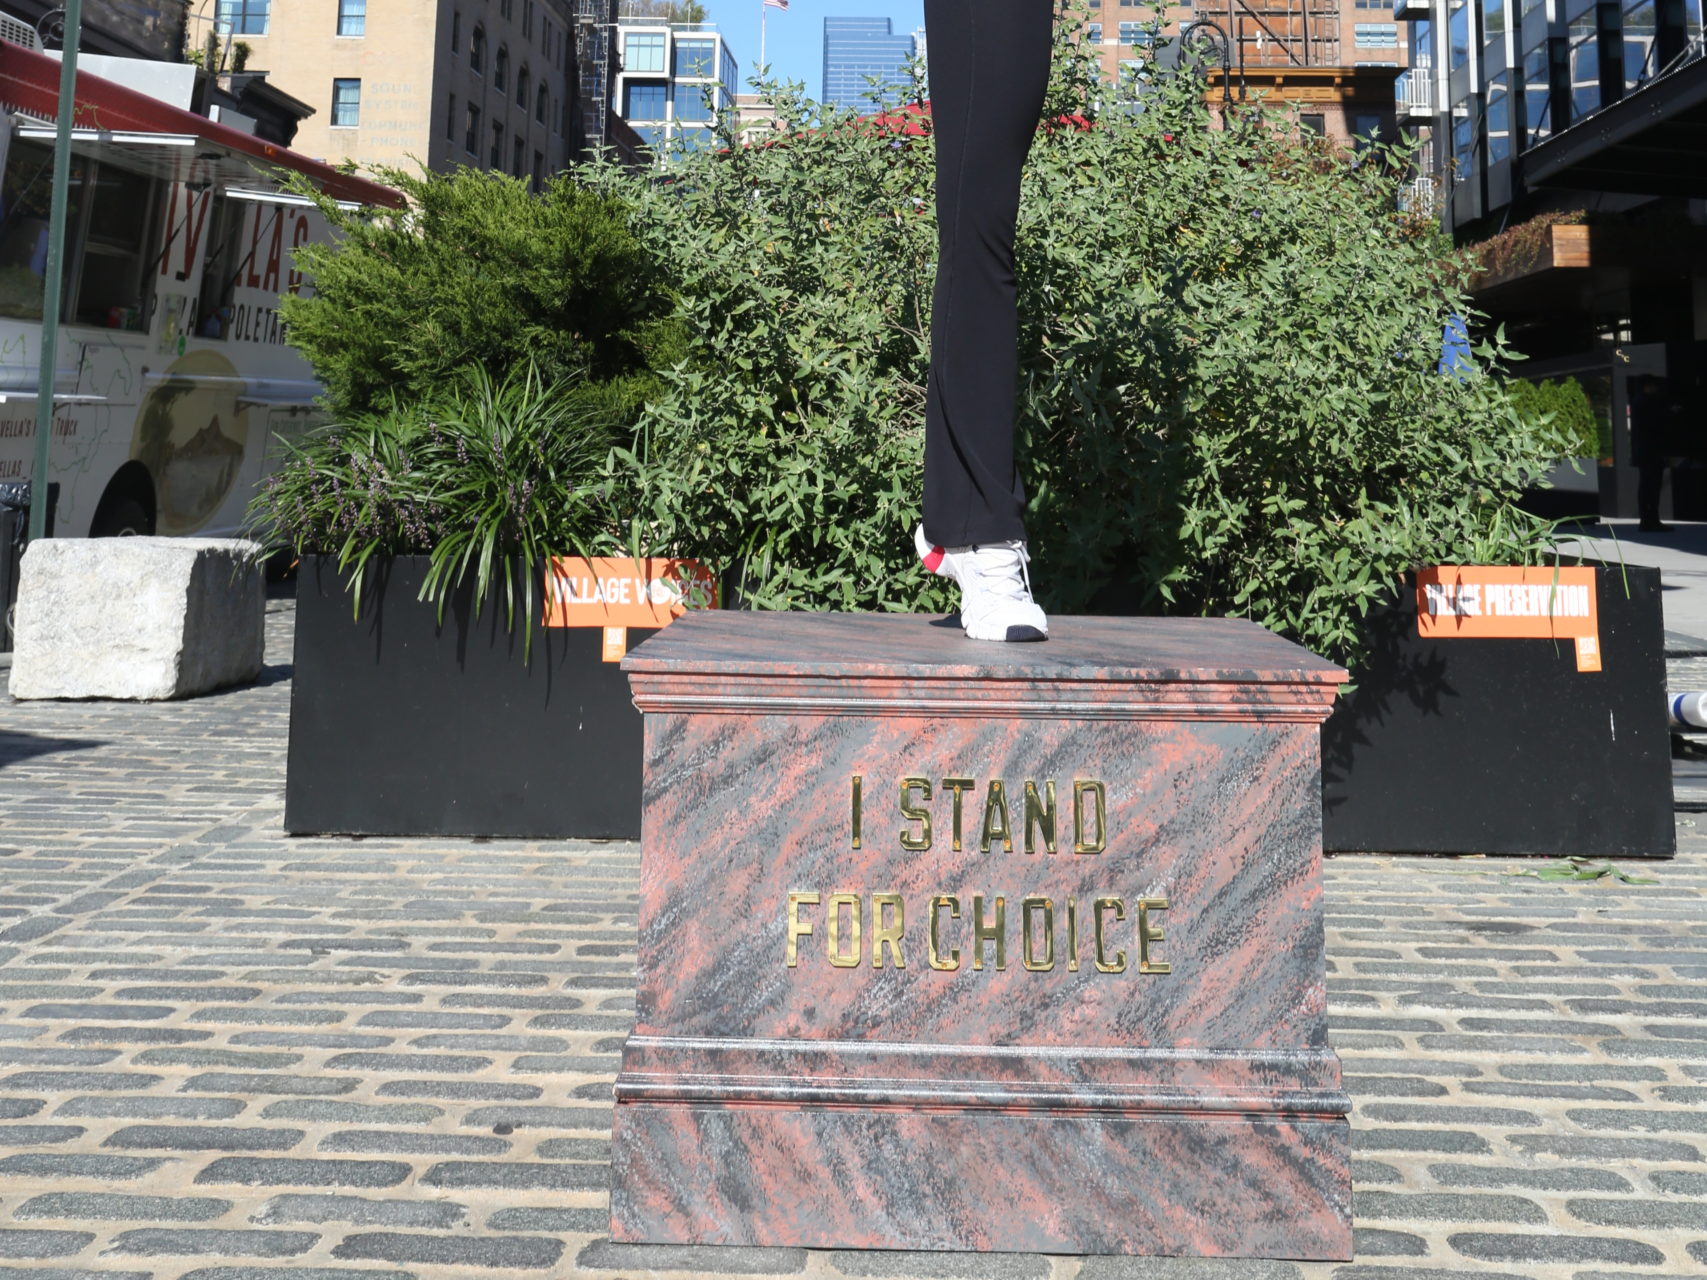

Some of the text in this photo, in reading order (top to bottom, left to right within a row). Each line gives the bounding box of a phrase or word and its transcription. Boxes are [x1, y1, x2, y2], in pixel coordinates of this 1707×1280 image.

[552, 576, 631, 605] VILLAGE
[1425, 583, 1590, 618] VILLAGE PRESERVATION
[850, 775, 1107, 855] I STAND
[786, 892, 1172, 975] FOR CHOICE
